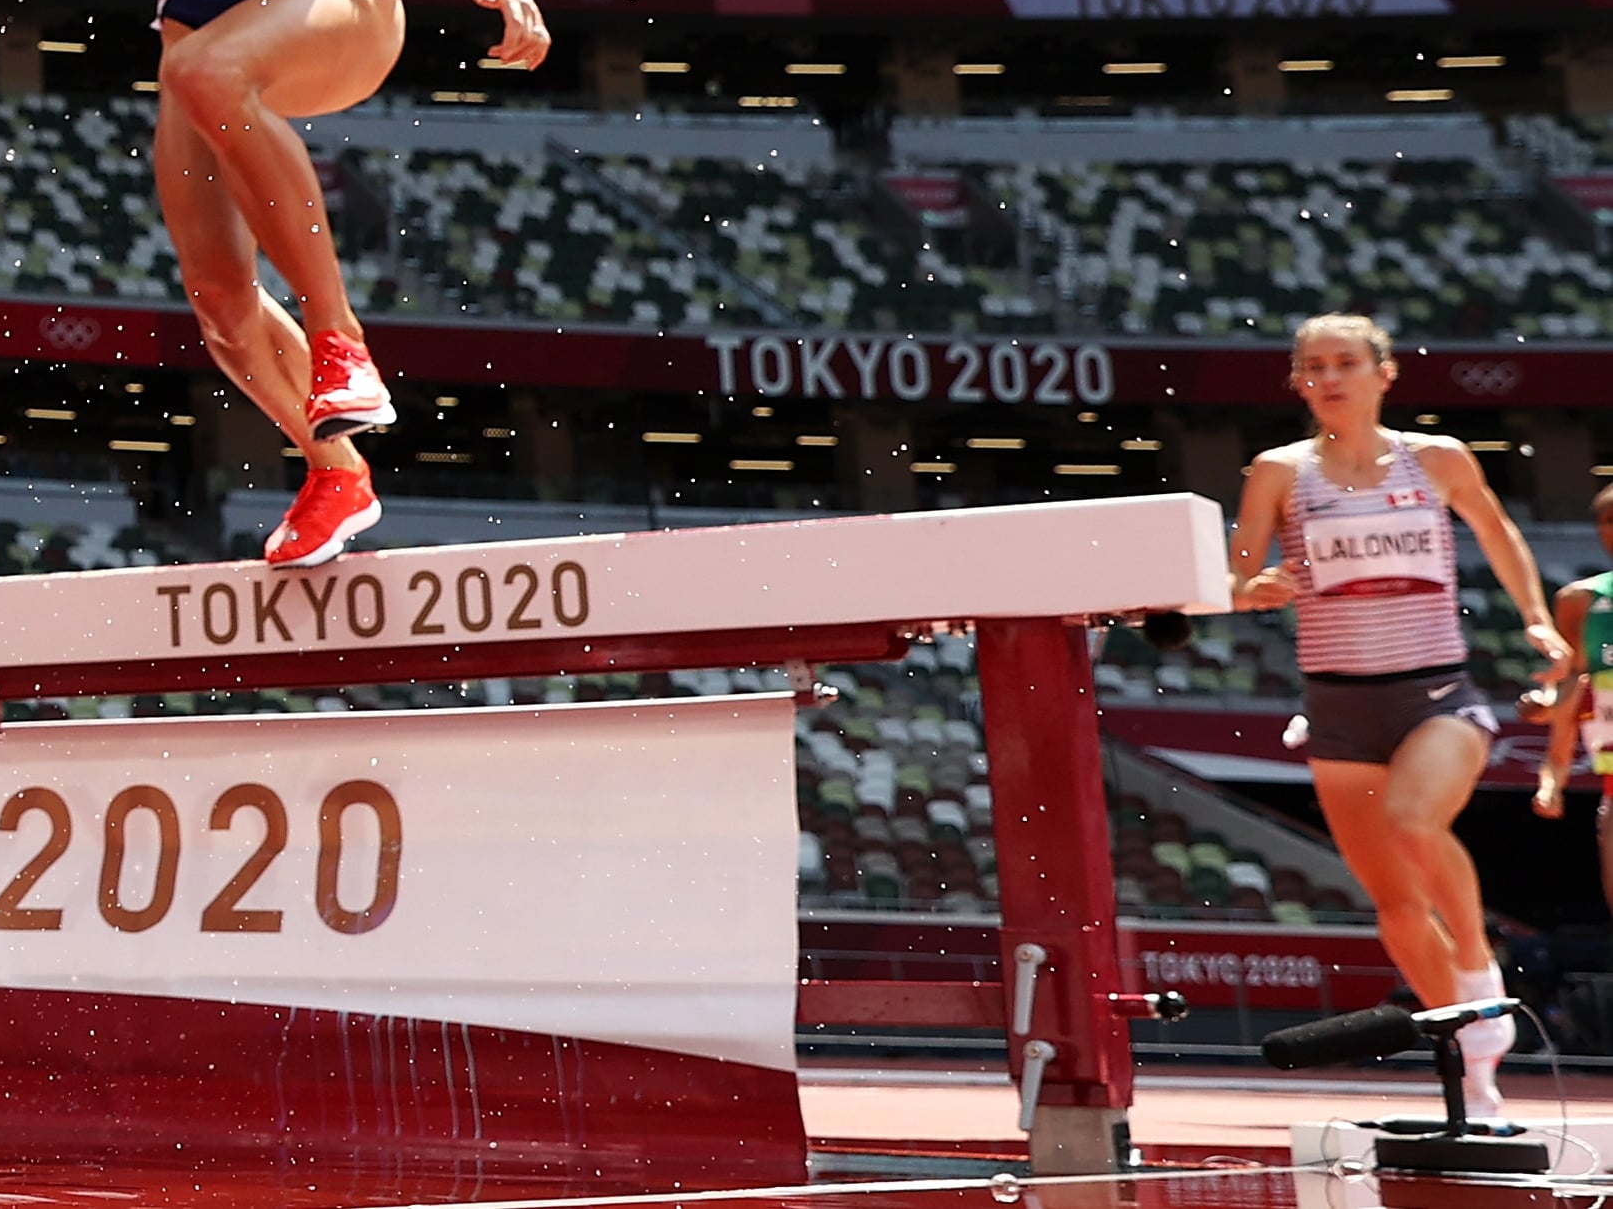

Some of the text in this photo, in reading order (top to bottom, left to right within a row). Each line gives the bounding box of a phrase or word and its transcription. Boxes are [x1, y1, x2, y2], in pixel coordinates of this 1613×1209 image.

[705, 334, 1116, 405] TOKYO 2020
[1312, 529, 1432, 562] LALONDE
[157, 561, 590, 648] TOKYO 2020
[1141, 950, 1322, 988] TOKYO 2020
